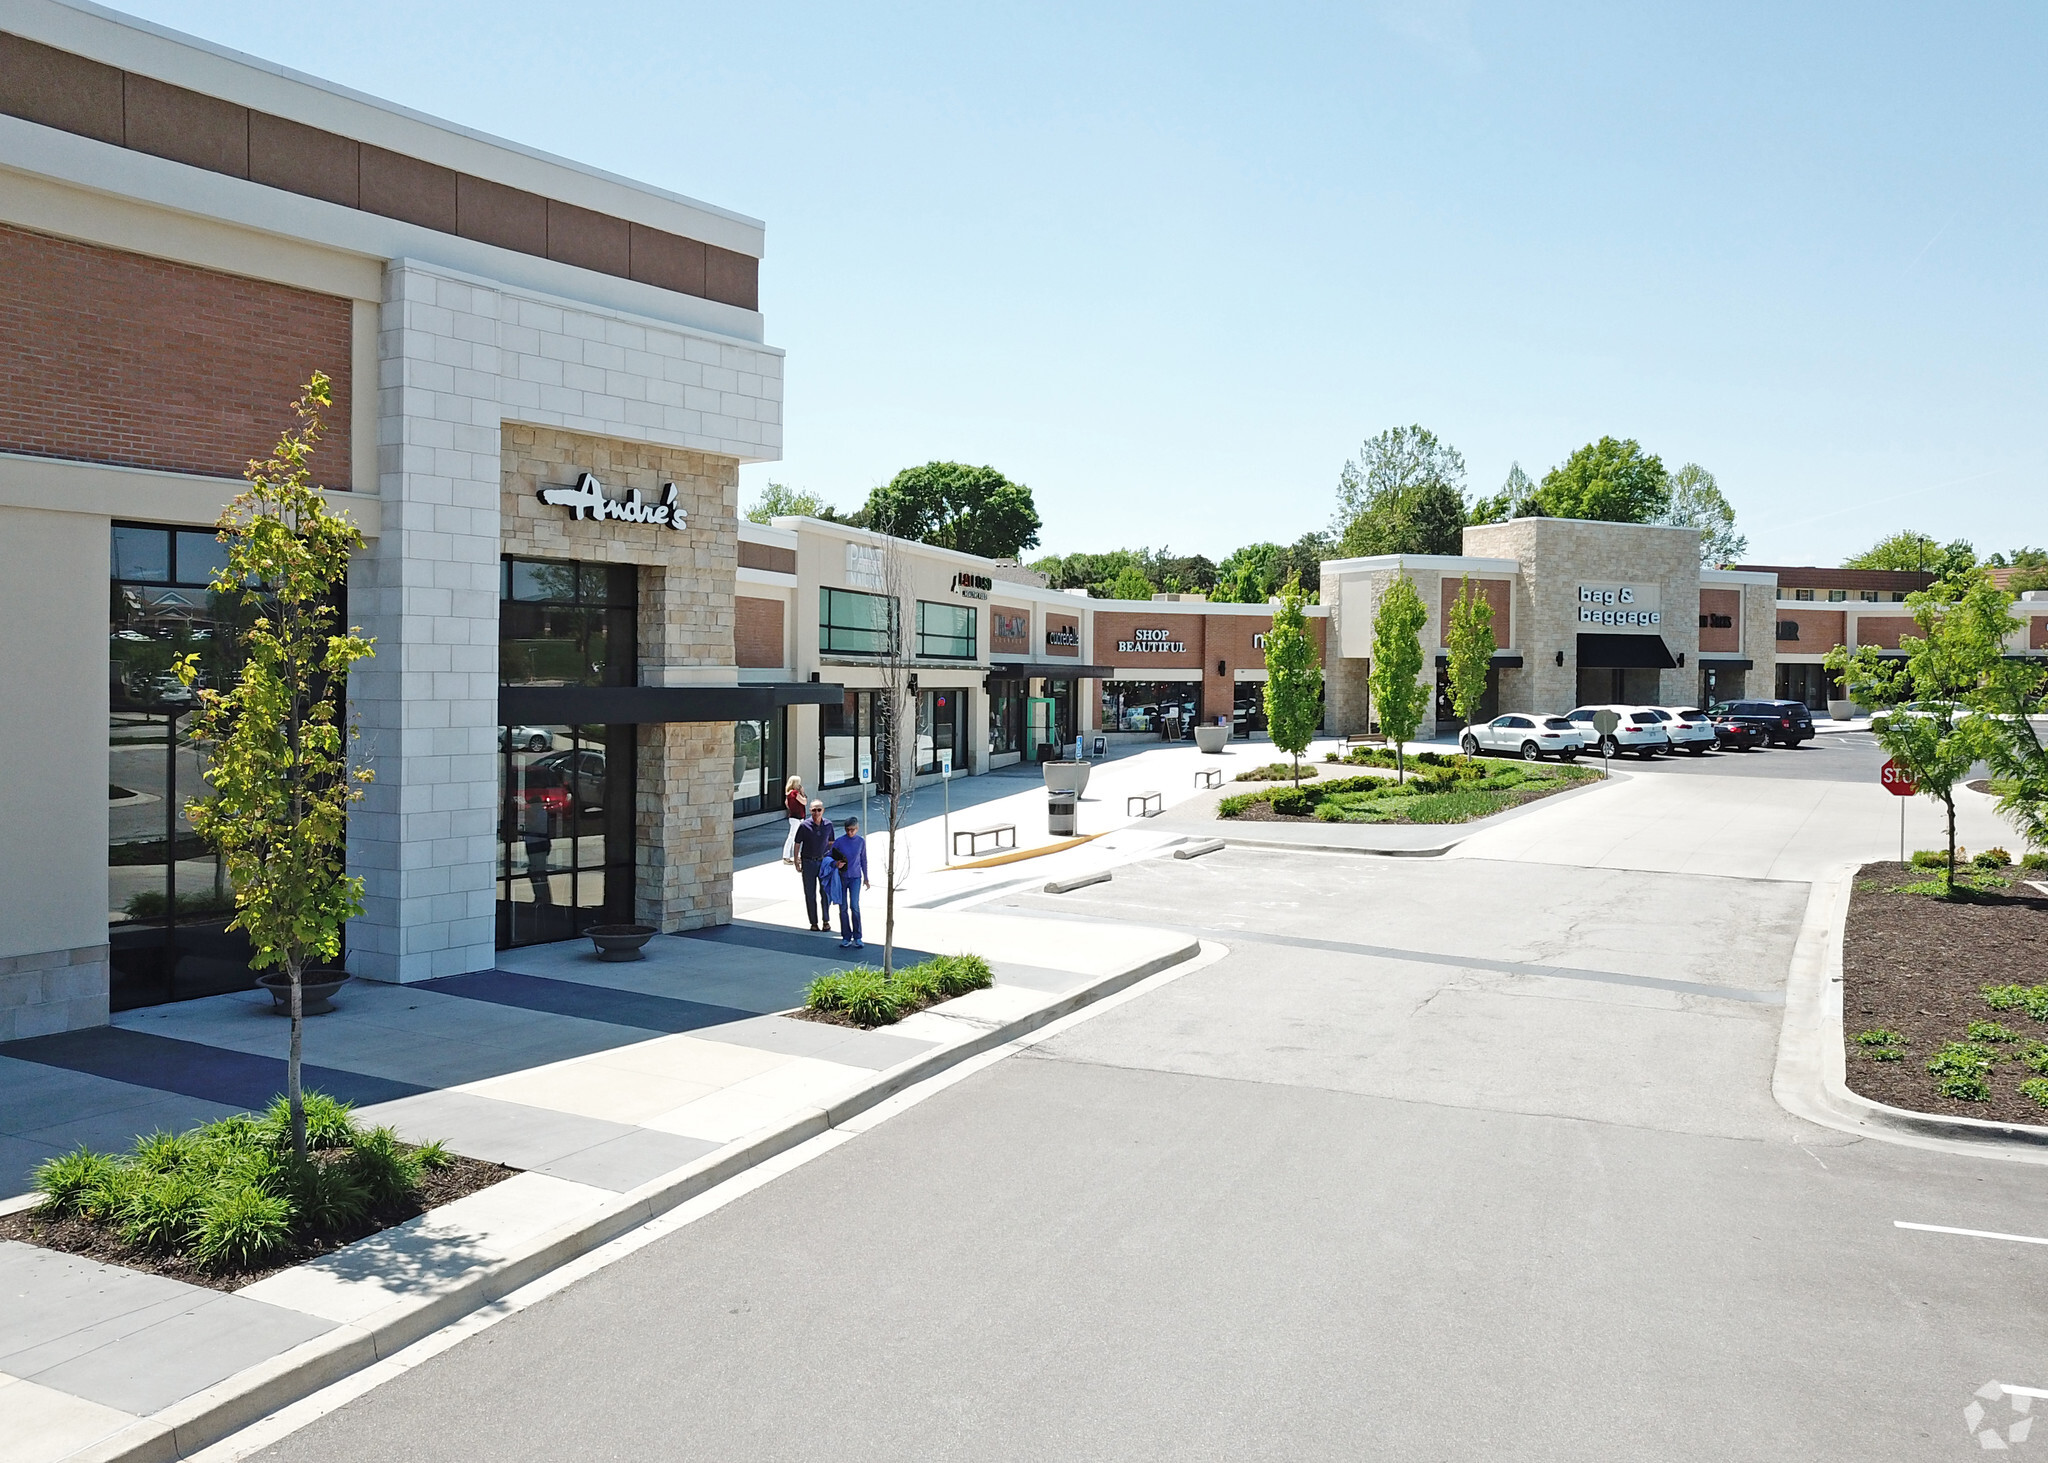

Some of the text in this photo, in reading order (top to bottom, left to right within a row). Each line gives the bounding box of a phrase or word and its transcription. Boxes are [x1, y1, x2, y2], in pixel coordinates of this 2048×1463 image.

[537, 472, 688, 531] André's
[1579, 586, 1635, 606] bag &
[1578, 606, 1660, 627] baggage
[1135, 629, 1170, 641] SHOP
[1117, 641, 1187, 653] BEAUTIFUL
